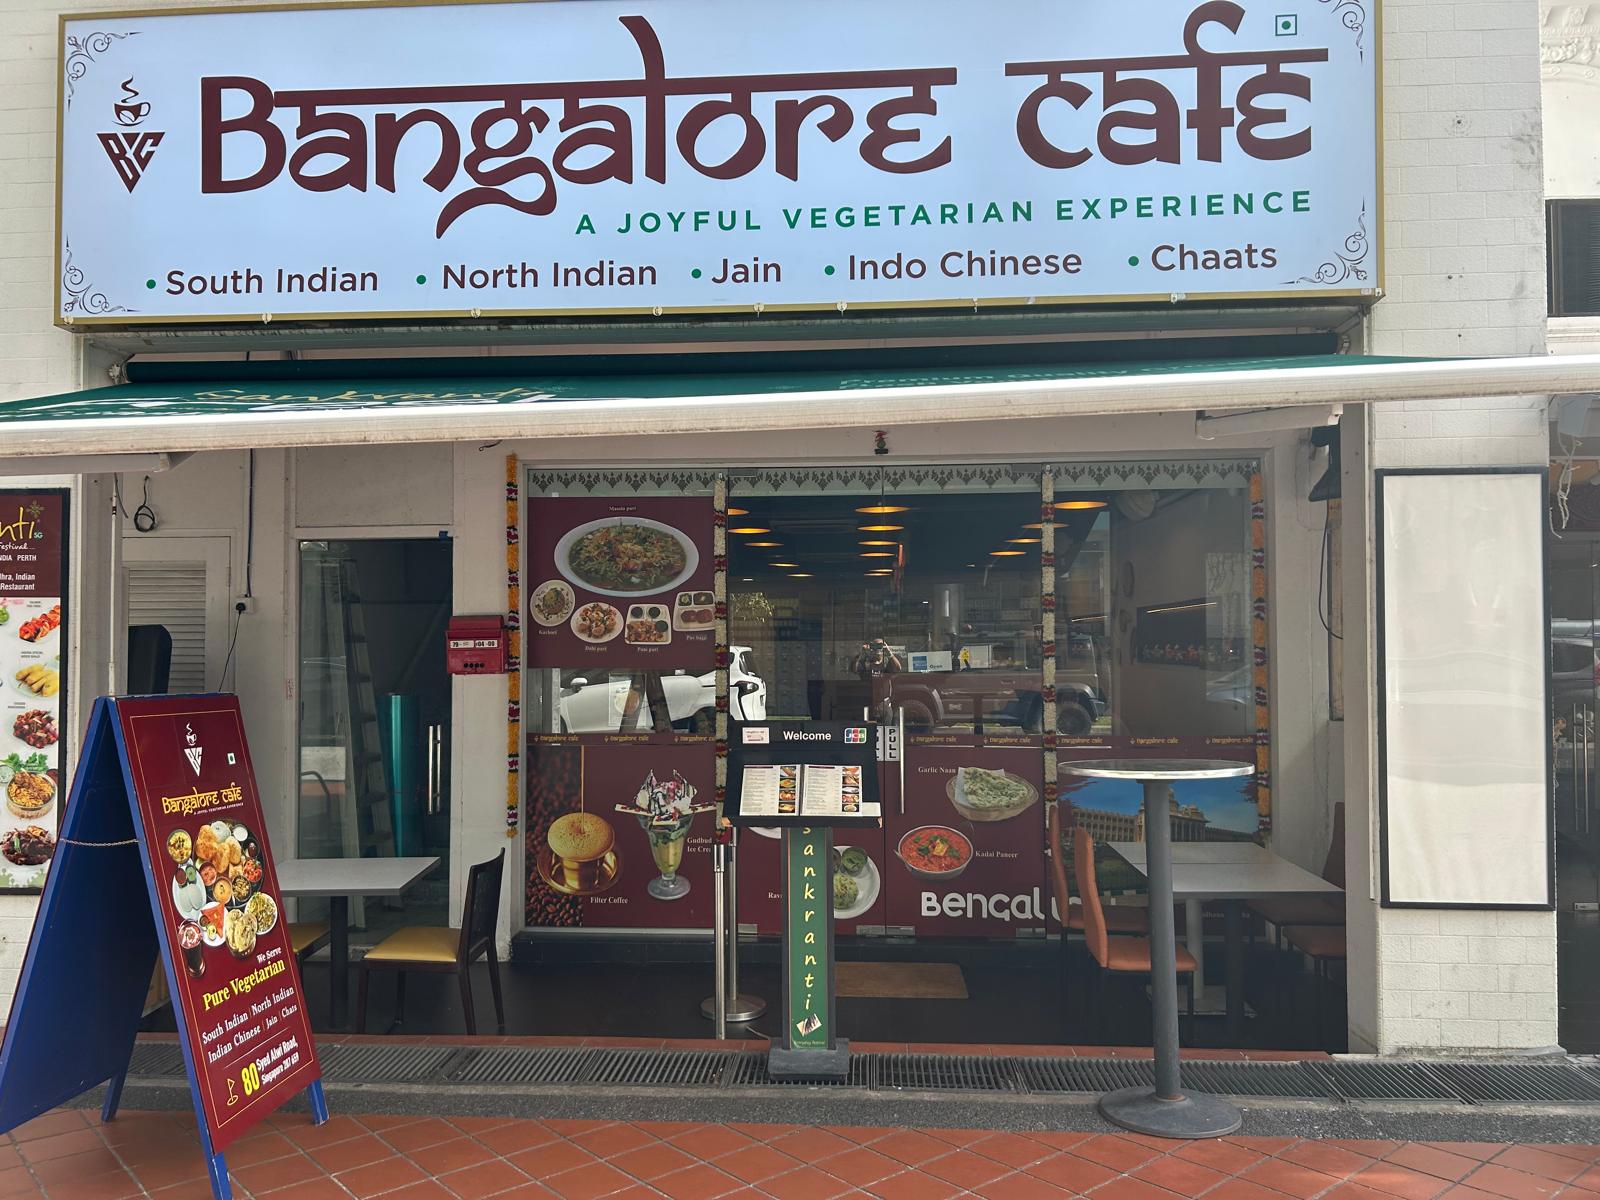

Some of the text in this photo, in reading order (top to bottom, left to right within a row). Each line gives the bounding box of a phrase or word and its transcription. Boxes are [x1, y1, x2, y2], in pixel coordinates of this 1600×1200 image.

[200, 0, 1329, 240] Bangalore cafe
[575, 190, 1311, 235] A JOYFUL VEGETARIAN EXPERIENCE
[165, 243, 1278, 296] South Indian North Indian Jain Indo Chinese Chaats
[17, 554, 37, 562] PERTH
[15, 573, 36, 581] Indian
[783, 730, 832, 741] Welcome
[888, 729, 897, 759] PULL
[918, 766, 938, 774] Garlic
[161, 786, 219, 817] Bangalore
[590, 896, 629, 904] Filter Coffee
[256, 946, 282, 964] We Serve
[202, 959, 286, 1011] Pure Vegetarian
[202, 986, 295, 1045] South Indian North Indian
[208, 1004, 298, 1063] Indian Chinese Jain Chats
[256, 1052, 271, 1072] Syed
[241, 1062, 260, 1096] 80
